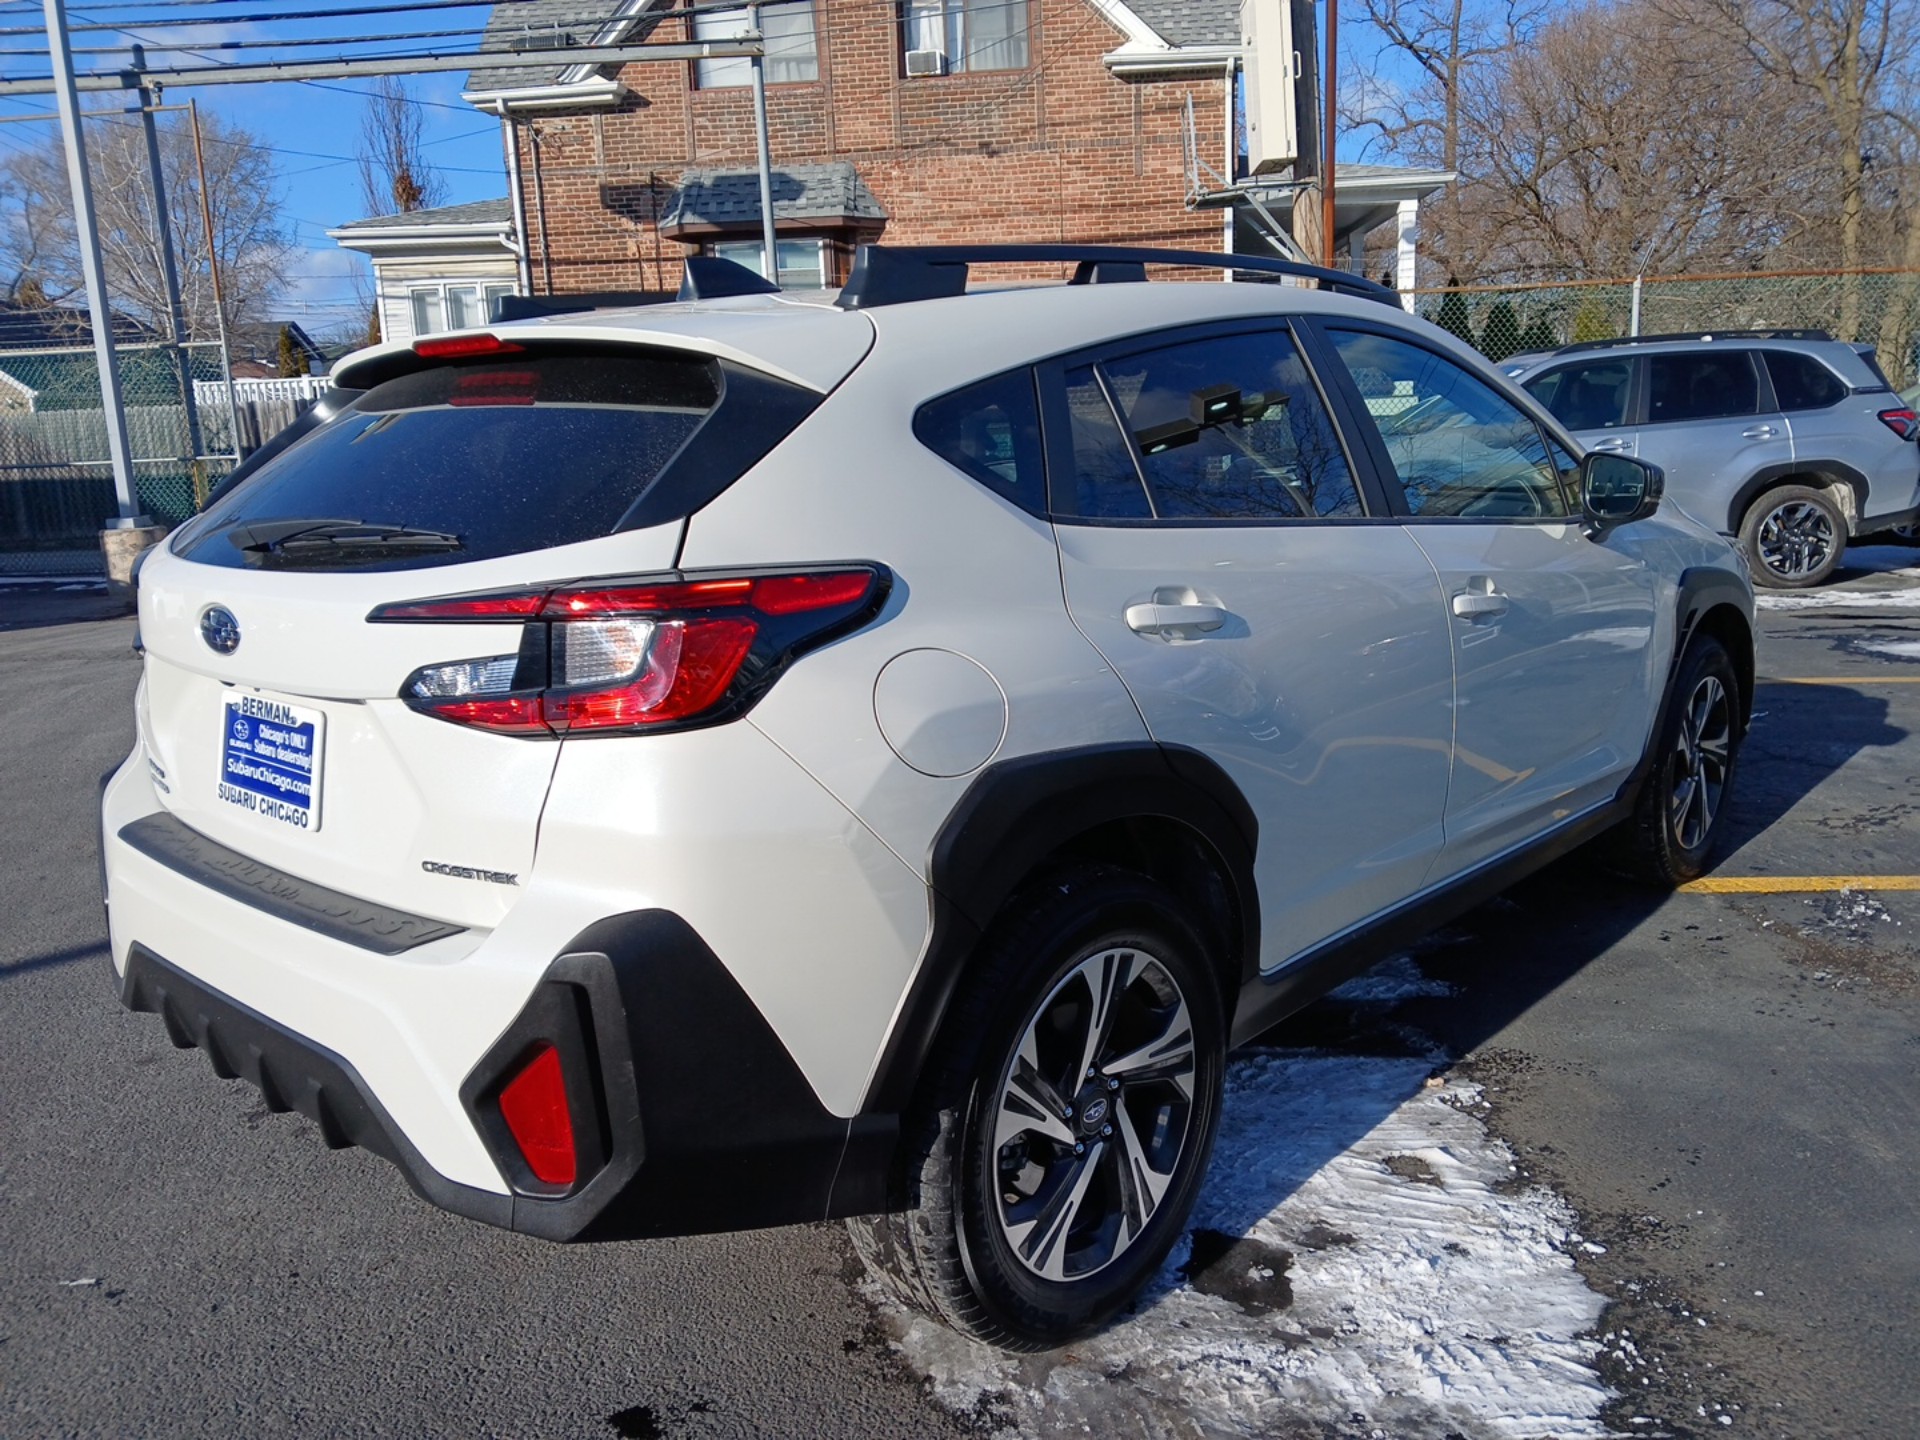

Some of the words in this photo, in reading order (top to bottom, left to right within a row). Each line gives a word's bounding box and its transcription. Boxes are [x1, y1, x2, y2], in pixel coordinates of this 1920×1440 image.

[242, 696, 290, 724] BERMAN
[259, 723, 289, 746] Chicago's
[254, 739, 276, 758] Subaru
[227, 758, 311, 796] SubaruChicago.com
[218, 783, 257, 811] SUBARU
[259, 797, 309, 829] CHICAGO
[421, 860, 520, 886] CROSSTREK
